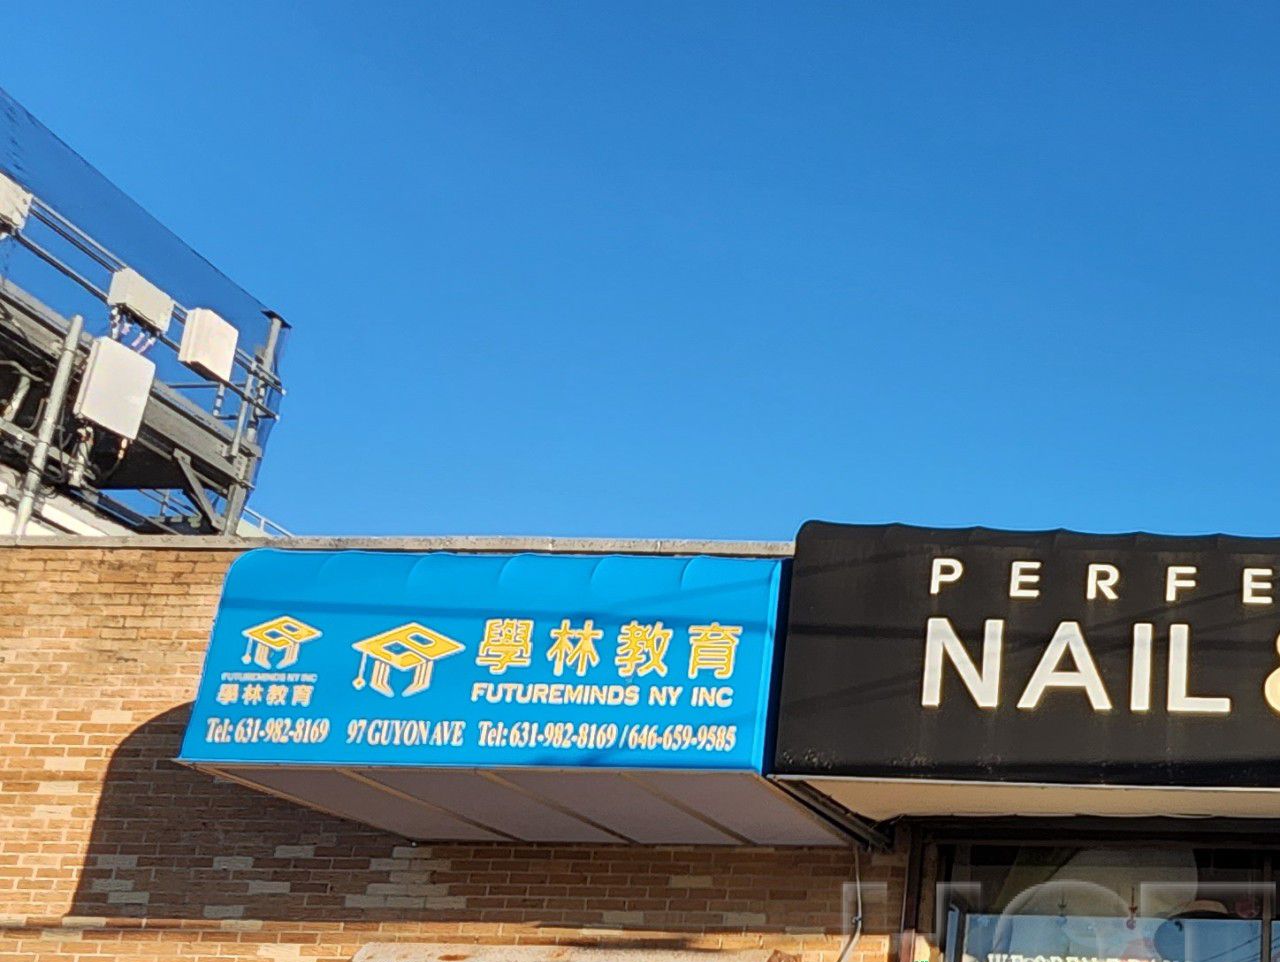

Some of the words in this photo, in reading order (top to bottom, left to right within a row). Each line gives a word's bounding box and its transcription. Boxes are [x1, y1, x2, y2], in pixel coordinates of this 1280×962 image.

[475, 618, 743, 680] 學林教育
[920, 616, 1231, 716] NAIL
[216, 684, 314, 707] 學林教育
[471, 682, 640, 706] FUTUREMINDS
[648, 686, 683, 706] NY
[691, 686, 734, 708] INC
[234, 718, 330, 744] 631-982-8169
[346, 720, 366, 744] 97
[367, 720, 431, 745] GUYON
[431, 721, 466, 746] AVE
[509, 722, 617, 750] 631-982-8169
